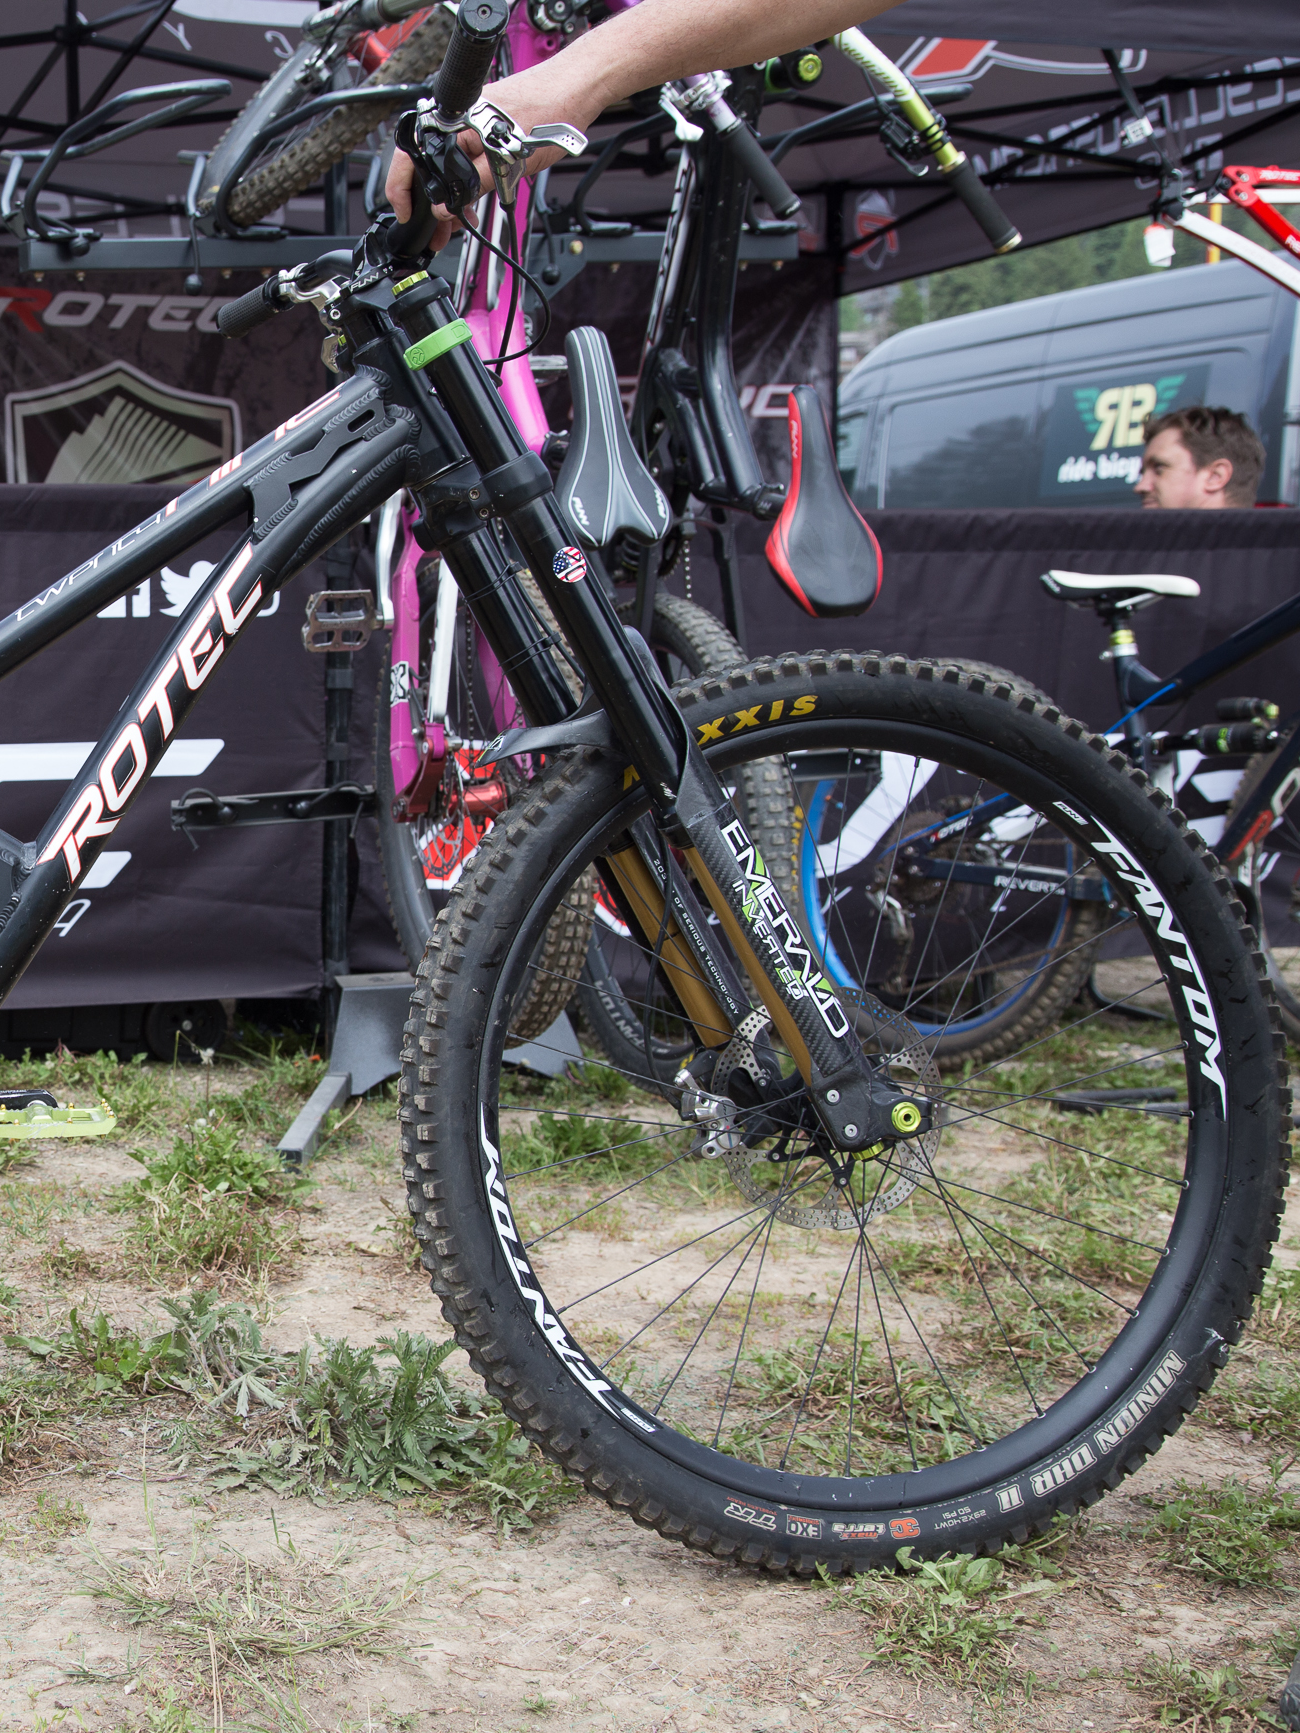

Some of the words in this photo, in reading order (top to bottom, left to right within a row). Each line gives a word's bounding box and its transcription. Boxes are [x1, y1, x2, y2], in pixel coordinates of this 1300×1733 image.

[36, 541, 263, 884] ROTEC
[681, 912, 706, 952] SERIOUS
[720, 819, 852, 1038] EMERALD
[1090, 815, 1228, 1122] FANTOM
[479, 1101, 621, 1419] FANTOM
[1095, 1350, 1187, 1456] MINION
[1029, 1441, 1097, 1498] DHR
[724, 1501, 778, 1532] TR
[790, 1520, 820, 1538] EXO
[889, 1517, 921, 1540] 3C
[933, 1508, 988, 1531] 29X2.40WT
